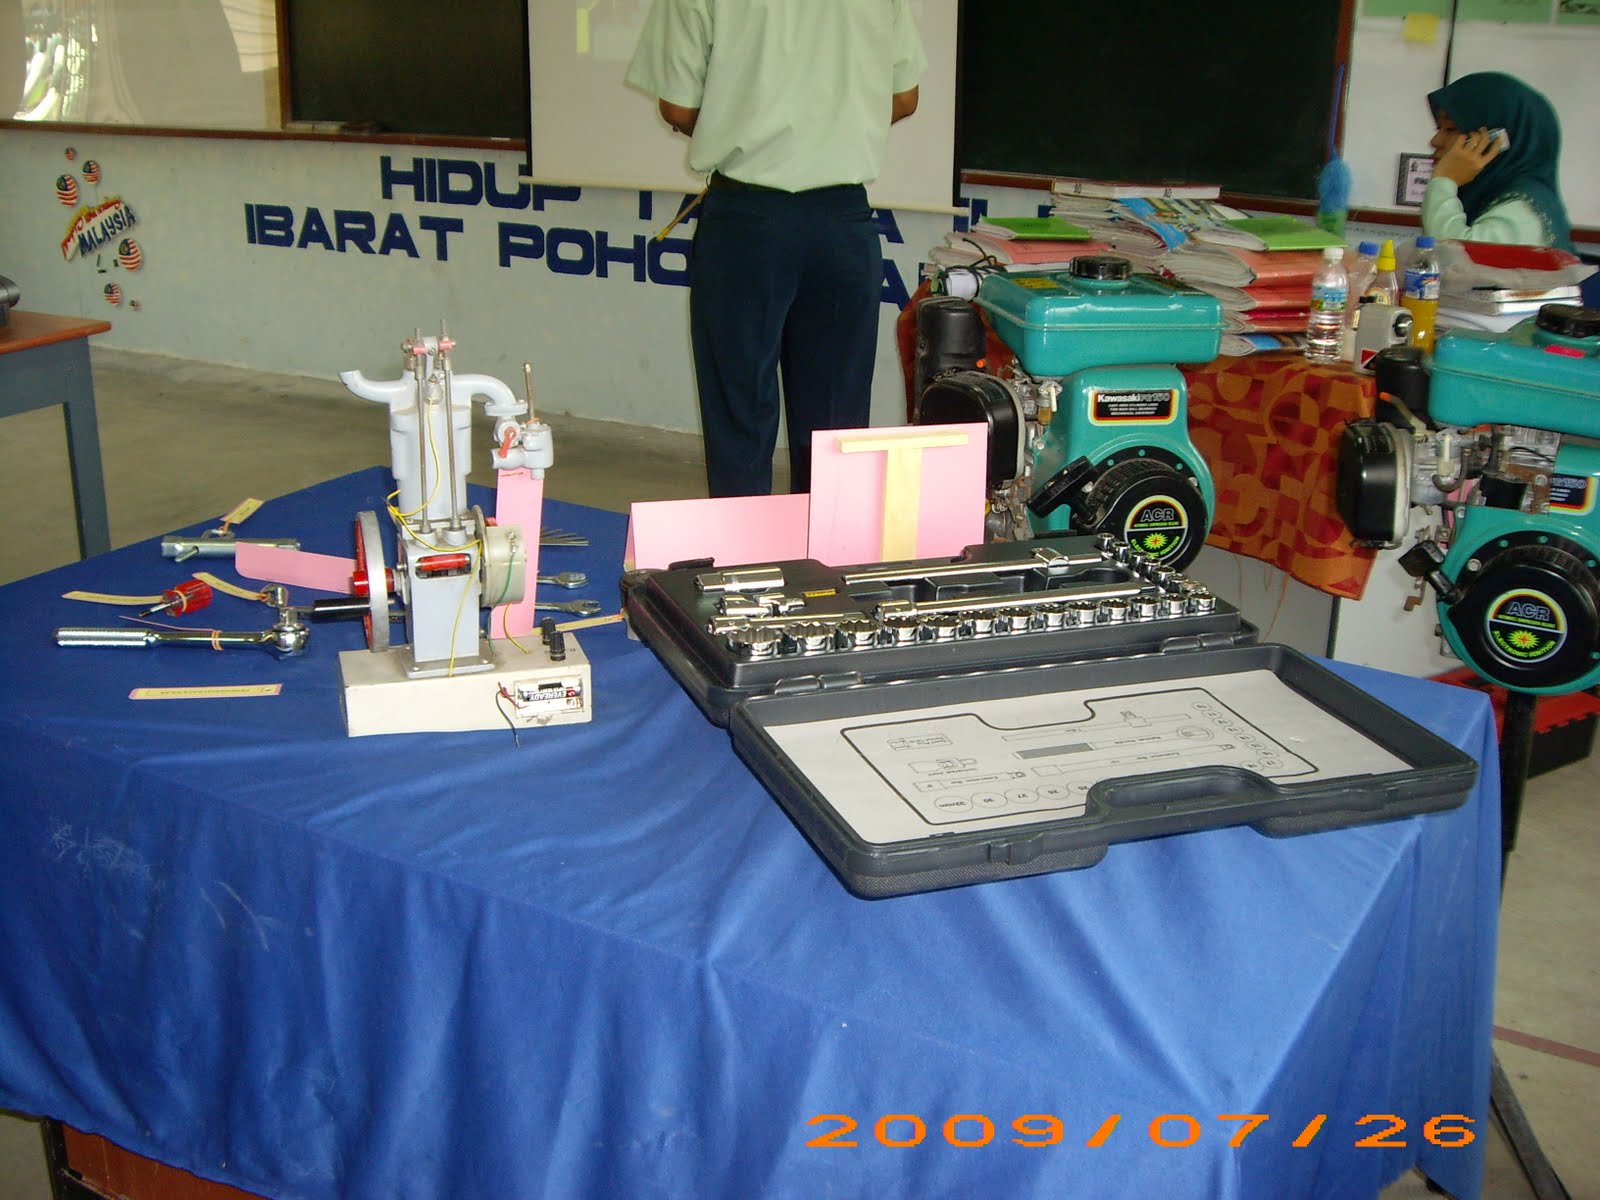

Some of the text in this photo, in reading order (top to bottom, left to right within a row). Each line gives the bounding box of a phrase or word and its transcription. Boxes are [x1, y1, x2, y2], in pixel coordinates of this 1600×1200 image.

[77, 205, 136, 257] MALAYSIA
[244, 203, 694, 288] IBARAT POHO
[1097, 393, 1140, 402] Kawasaki
[1140, 508, 1175, 522] ACR
[1507, 601, 1551, 621] ACR
